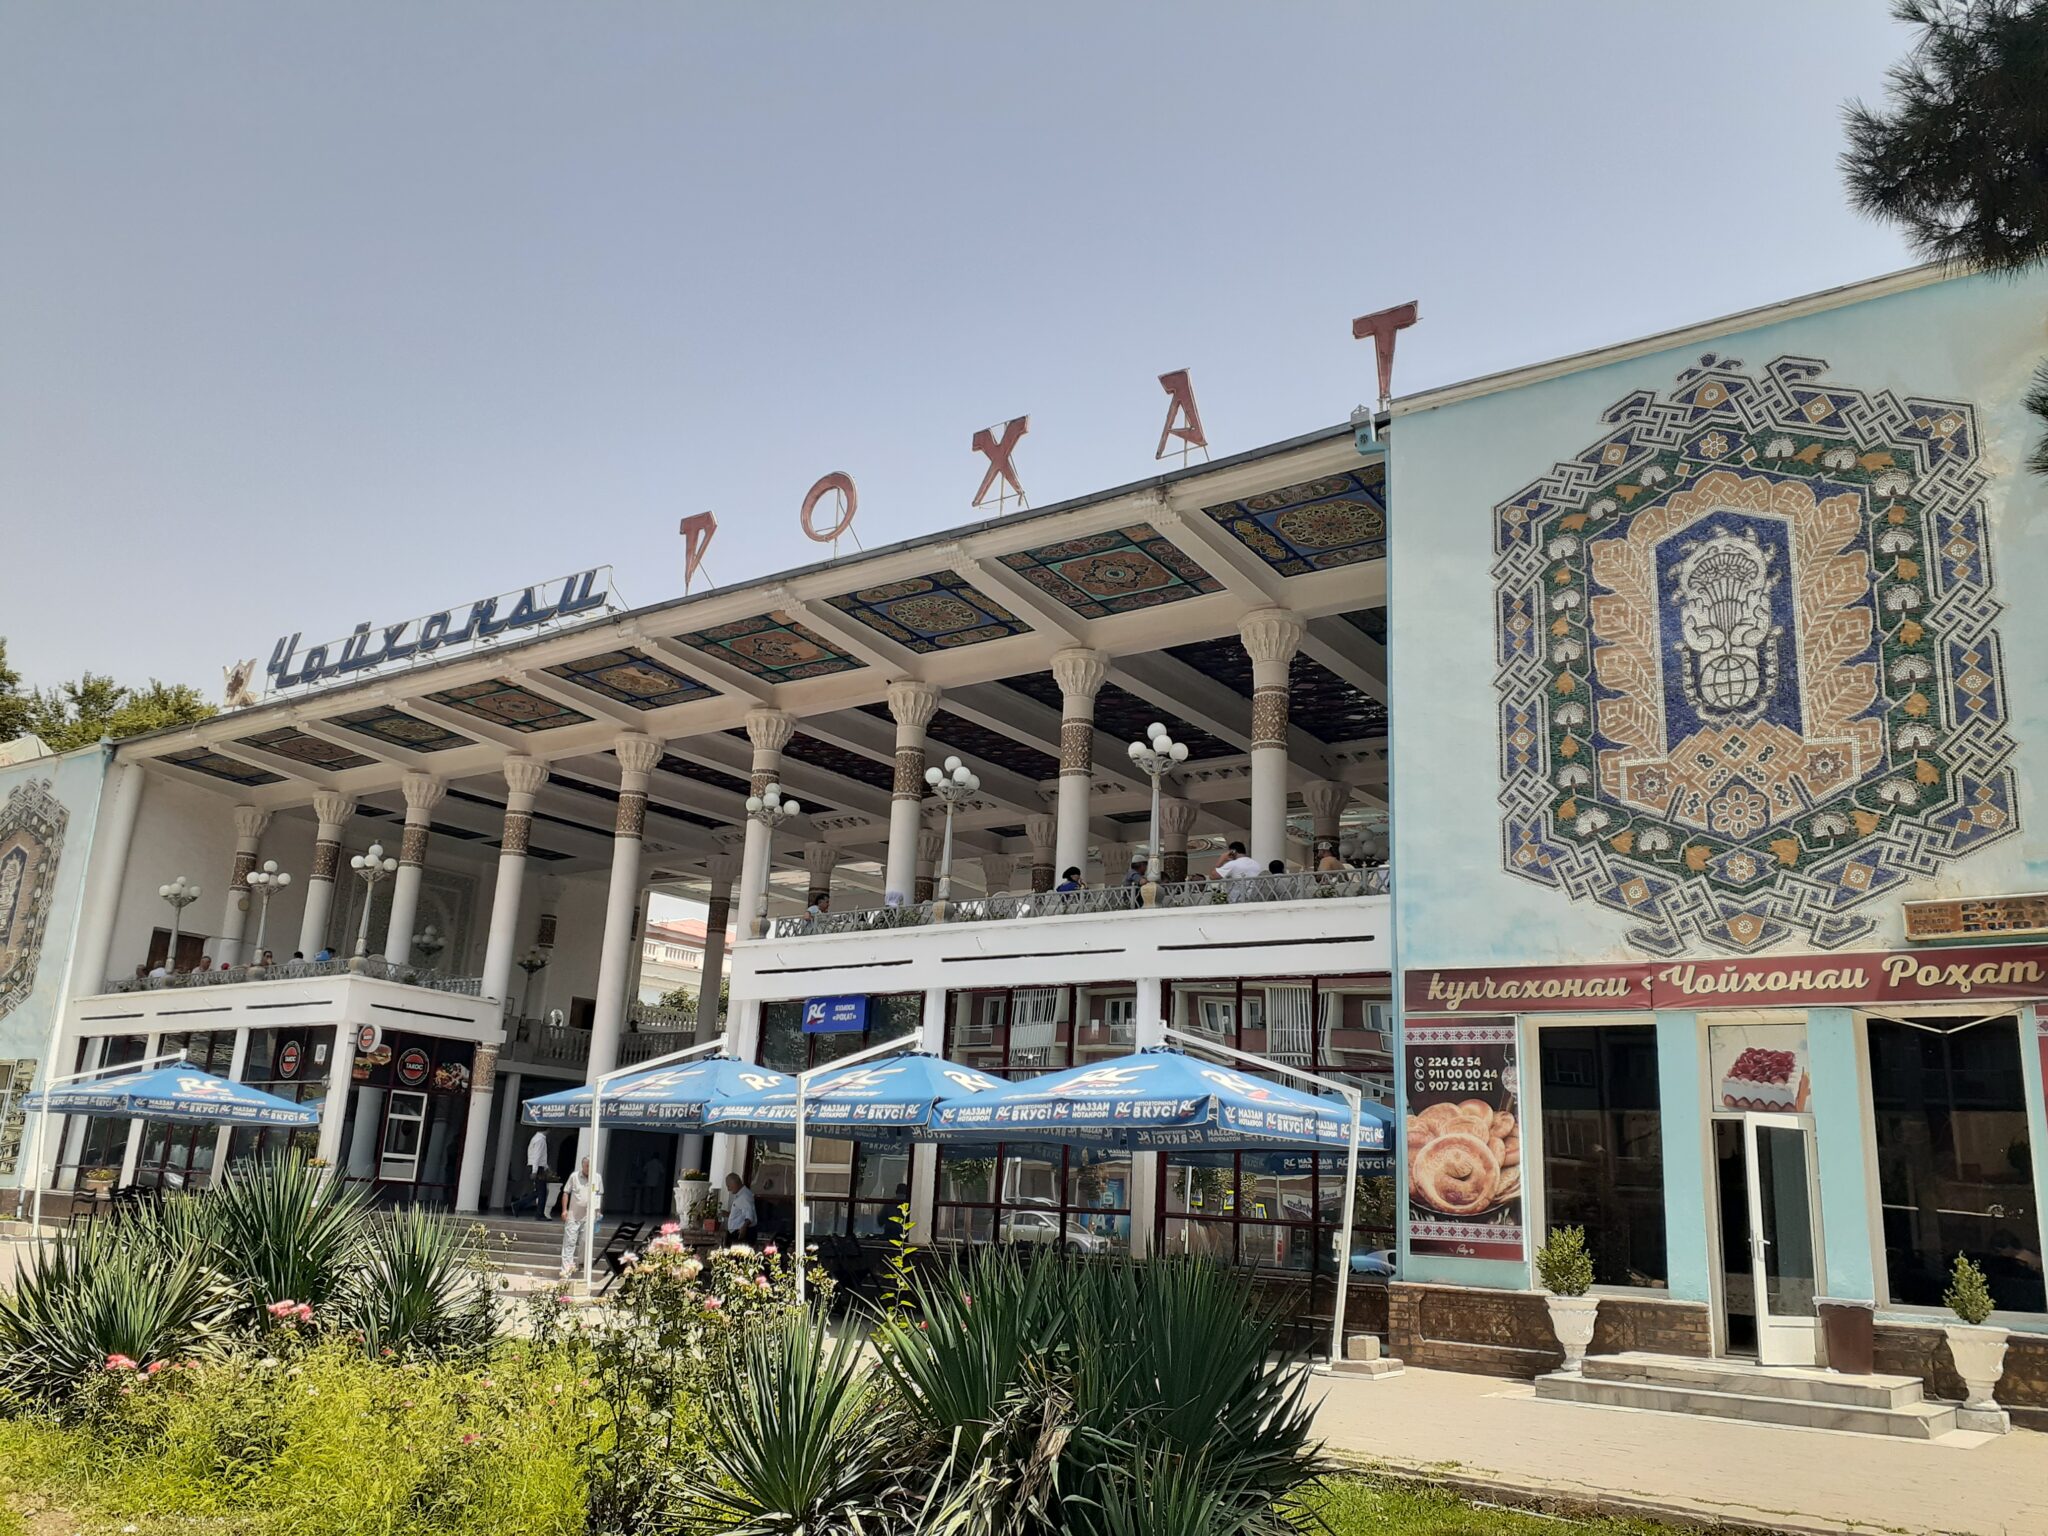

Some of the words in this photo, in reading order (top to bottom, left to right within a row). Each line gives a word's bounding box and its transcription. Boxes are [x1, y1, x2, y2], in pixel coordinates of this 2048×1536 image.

[1428, 972, 1631, 1010] кулчахонаи
[807, 1002, 827, 1024] RC
[1428, 1057, 1449, 1067] 224
[1450, 1057, 1465, 1067] 62
[1467, 1057, 1481, 1067] 54
[1428, 1069, 1445, 1079] 911
[1446, 1069, 1463, 1079] 00
[1465, 1069, 1481, 1079] 00
[1483, 1069, 1498, 1079] 44
[1428, 1081, 1450, 1091] 907
[1451, 1081, 1466, 1091] 24
[1467, 1081, 1480, 1091] 21
[1481, 1081, 1494, 1091] 21
[1072, 1102, 1110, 1111] МАЗЗАИ
